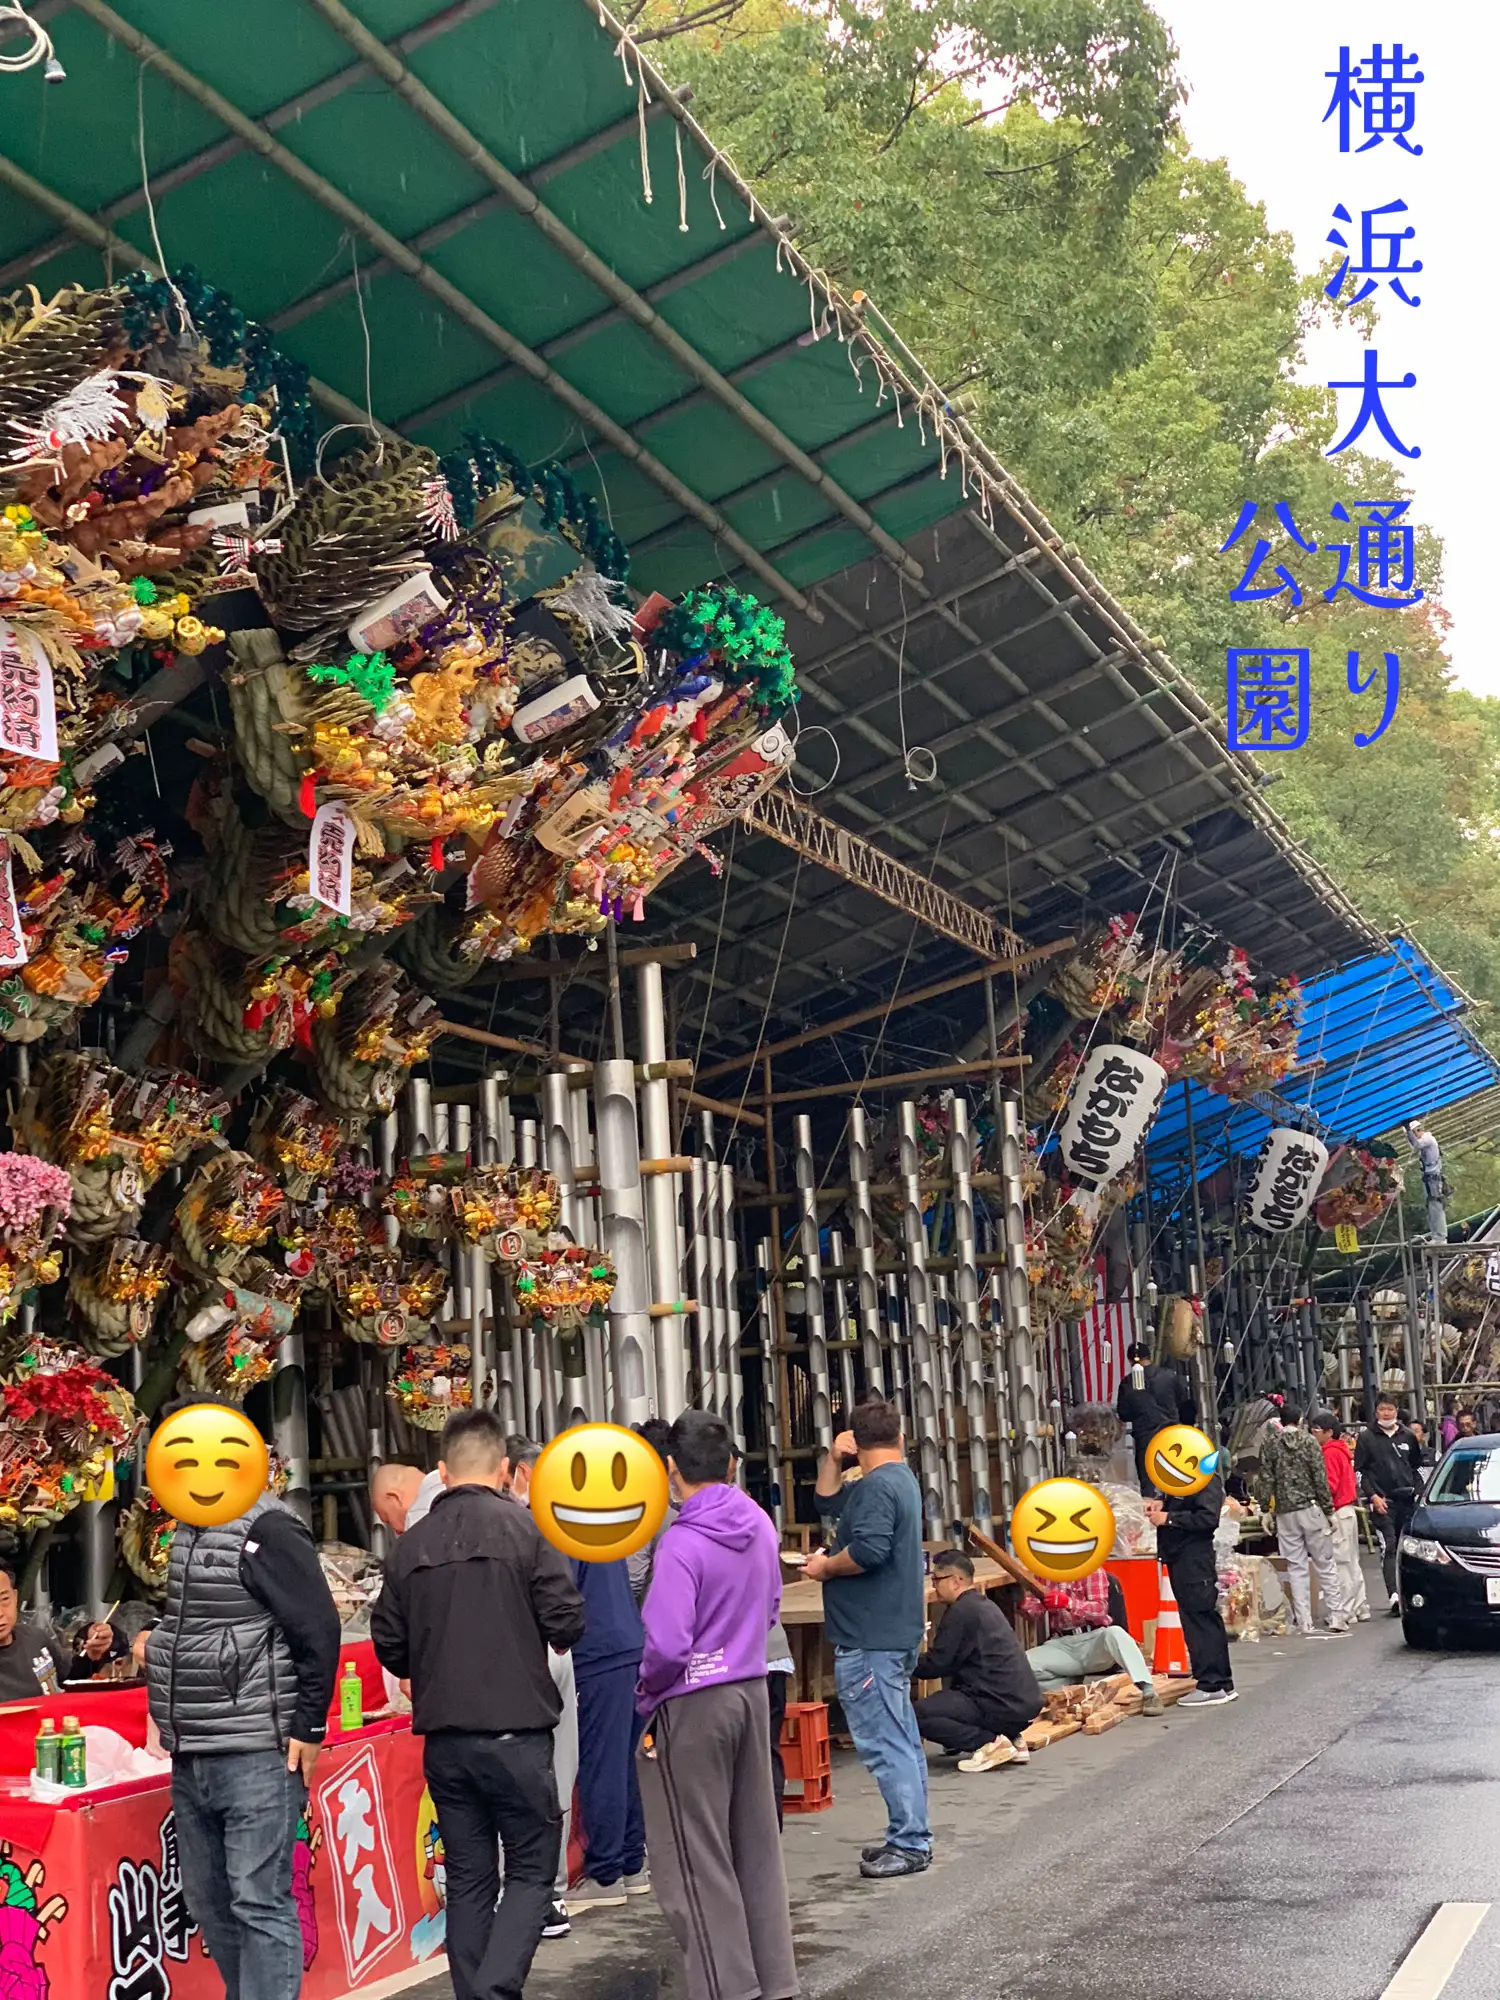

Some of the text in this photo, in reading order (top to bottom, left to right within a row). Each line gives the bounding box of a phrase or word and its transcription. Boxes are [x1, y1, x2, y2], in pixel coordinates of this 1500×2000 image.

[1069, 1056, 1144, 1175] ながもち
[1260, 1143, 1320, 1230] ながもち
